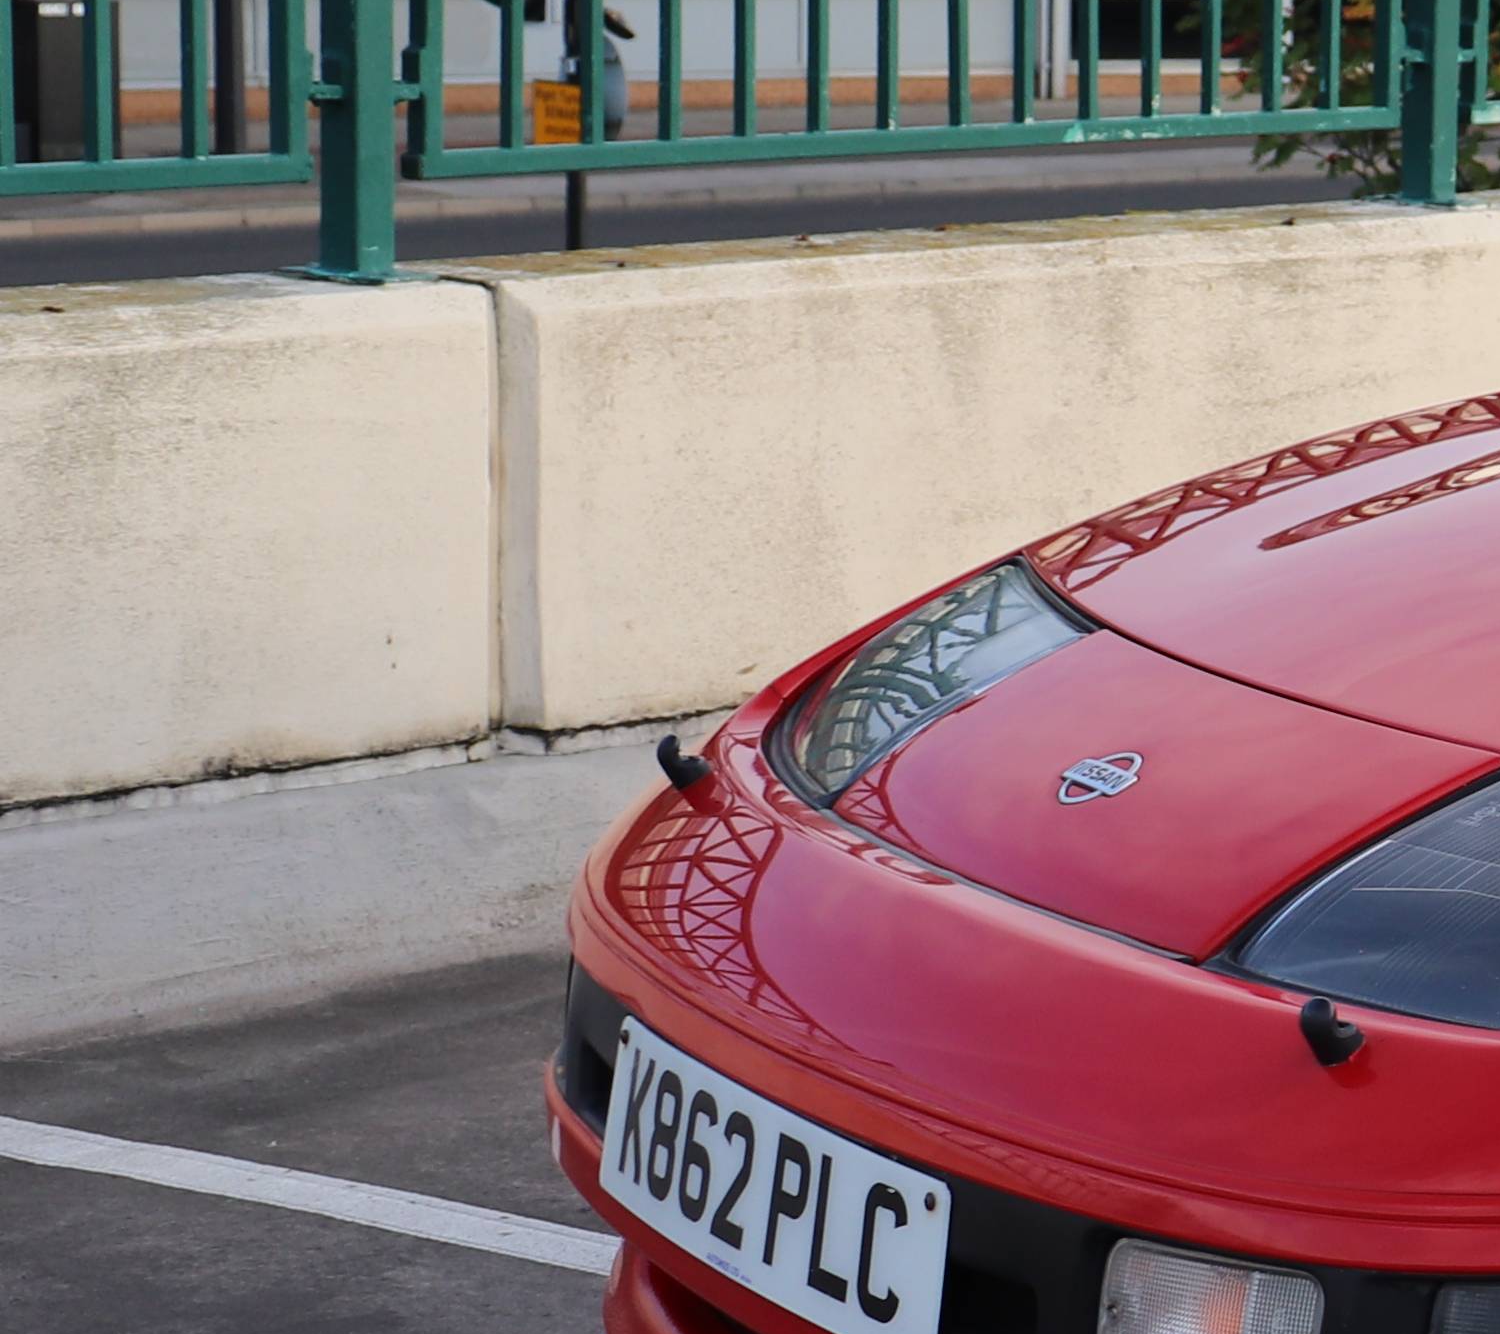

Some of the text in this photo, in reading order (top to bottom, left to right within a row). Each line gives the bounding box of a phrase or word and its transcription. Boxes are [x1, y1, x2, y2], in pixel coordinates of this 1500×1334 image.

[1071, 760, 1130, 790] NISSAN
[618, 1048, 909, 1324] K862 PLC
